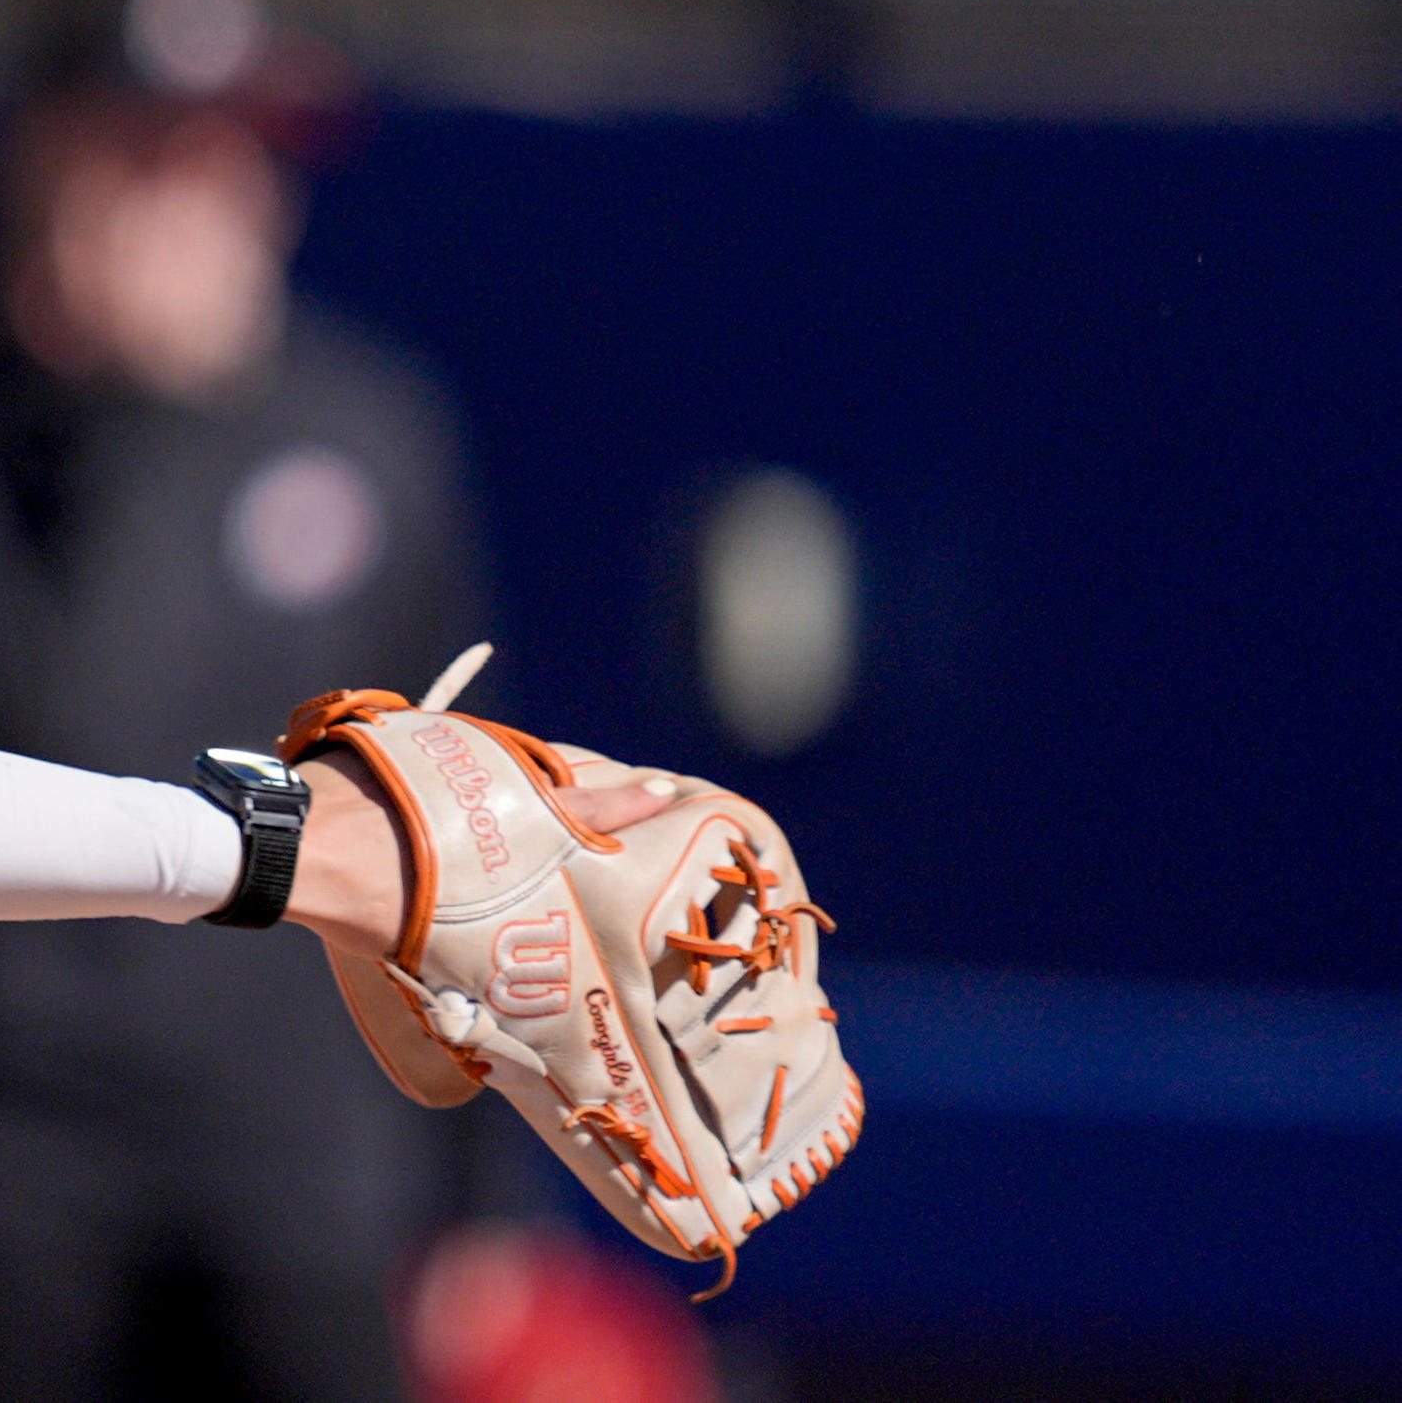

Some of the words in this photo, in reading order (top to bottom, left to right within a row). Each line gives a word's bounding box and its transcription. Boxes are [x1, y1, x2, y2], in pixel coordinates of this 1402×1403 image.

[410, 721, 510, 873] Wilson
[484, 910, 572, 1020] W
[585, 985, 633, 1088] Cowgirls
